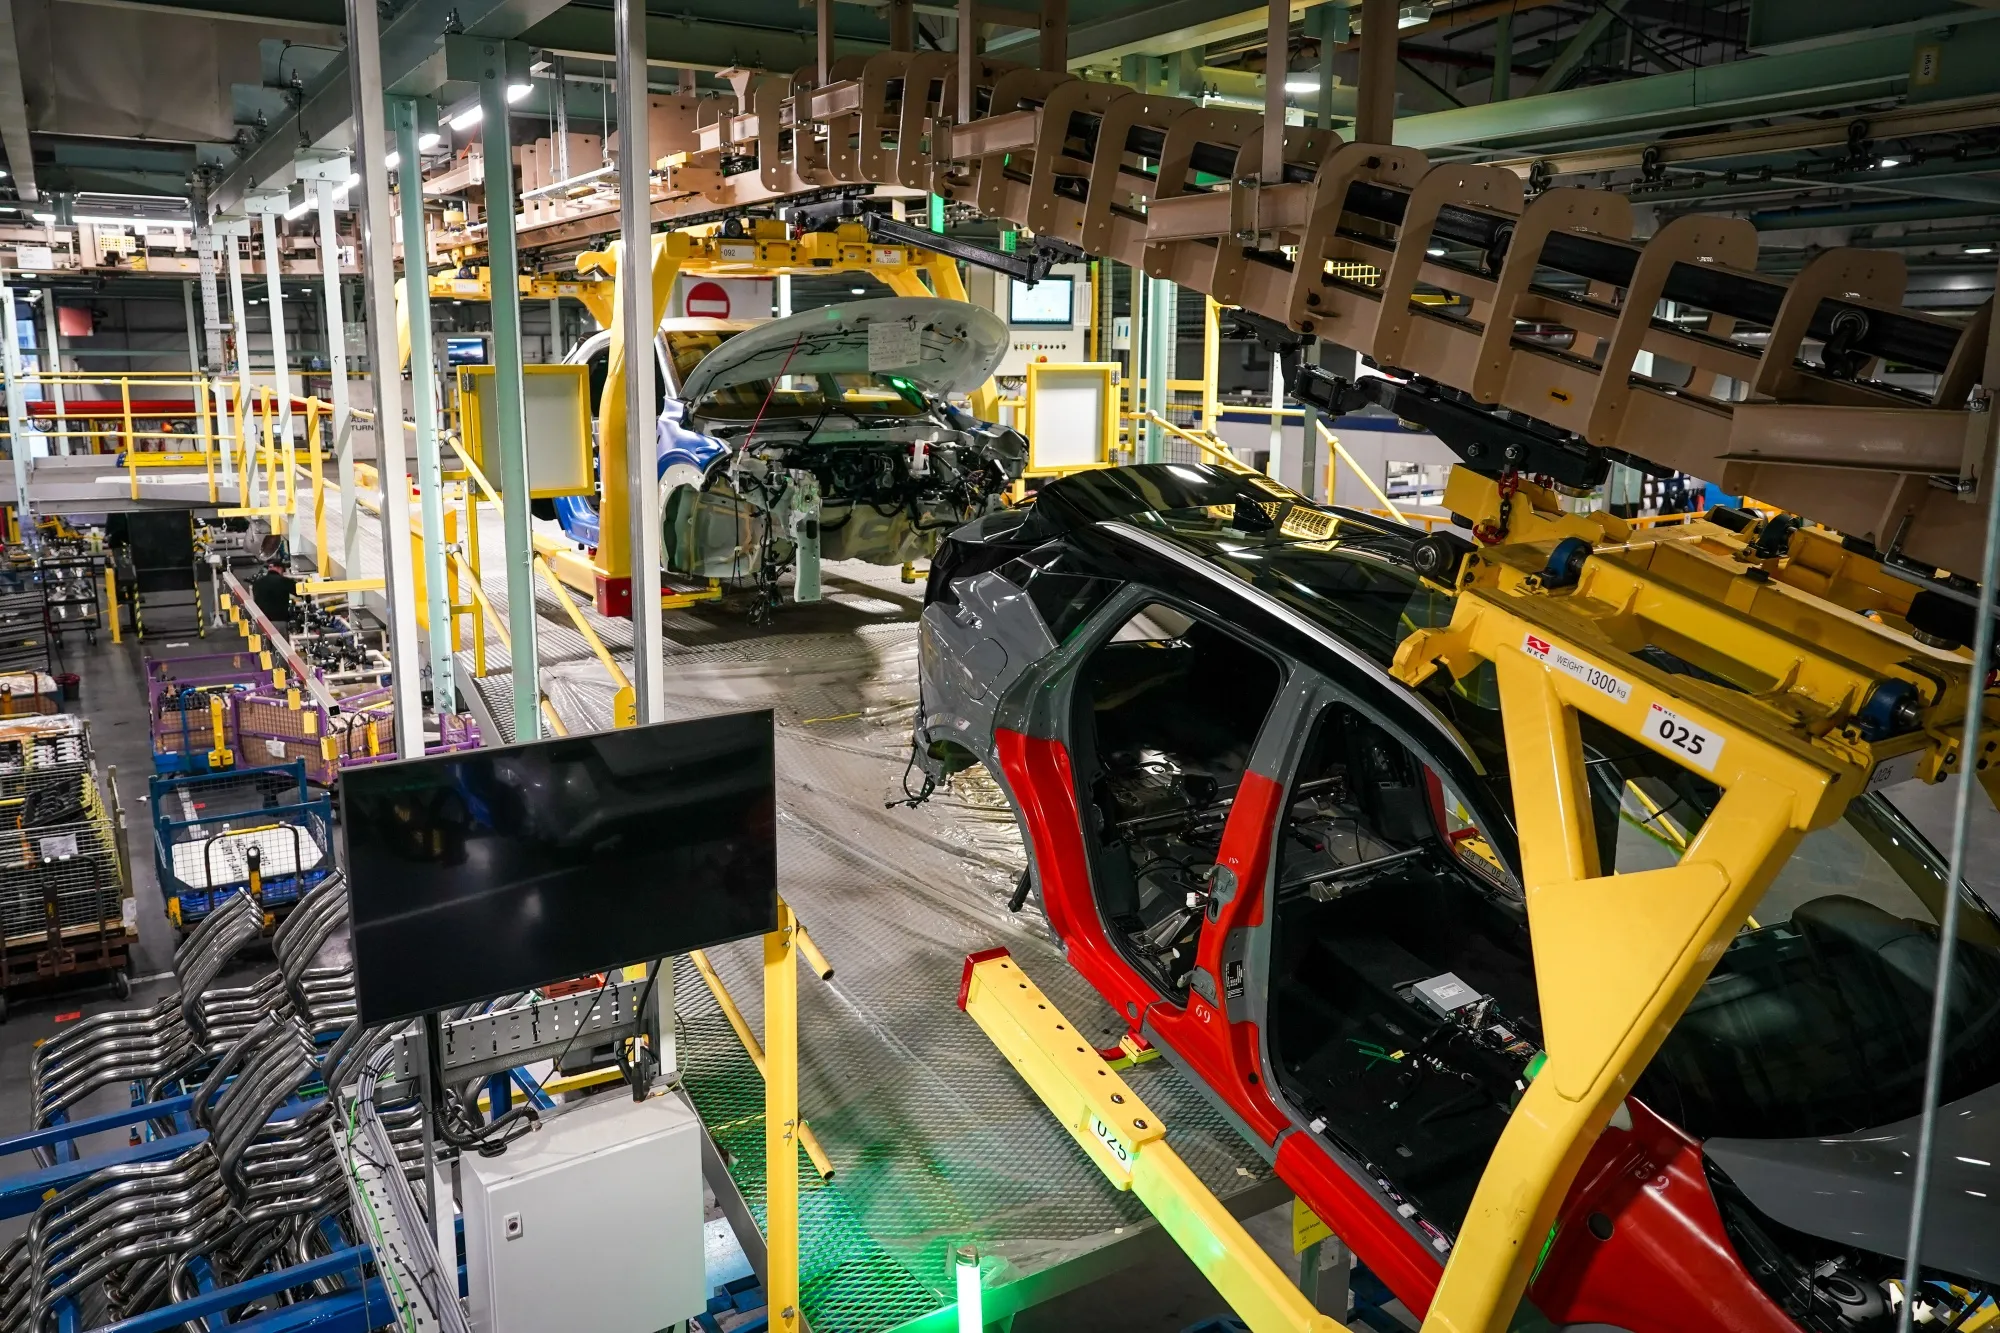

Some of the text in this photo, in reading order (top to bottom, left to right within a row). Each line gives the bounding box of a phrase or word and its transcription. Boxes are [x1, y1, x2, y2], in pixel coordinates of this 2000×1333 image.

[723, 248, 736, 257] 092
[1526, 647, 1545, 660] NKC
[1556, 654, 1627, 698] WEIGHT 1300 kg
[1659, 719, 1706, 755] 025
[1195, 1004, 1211, 1024] 69
